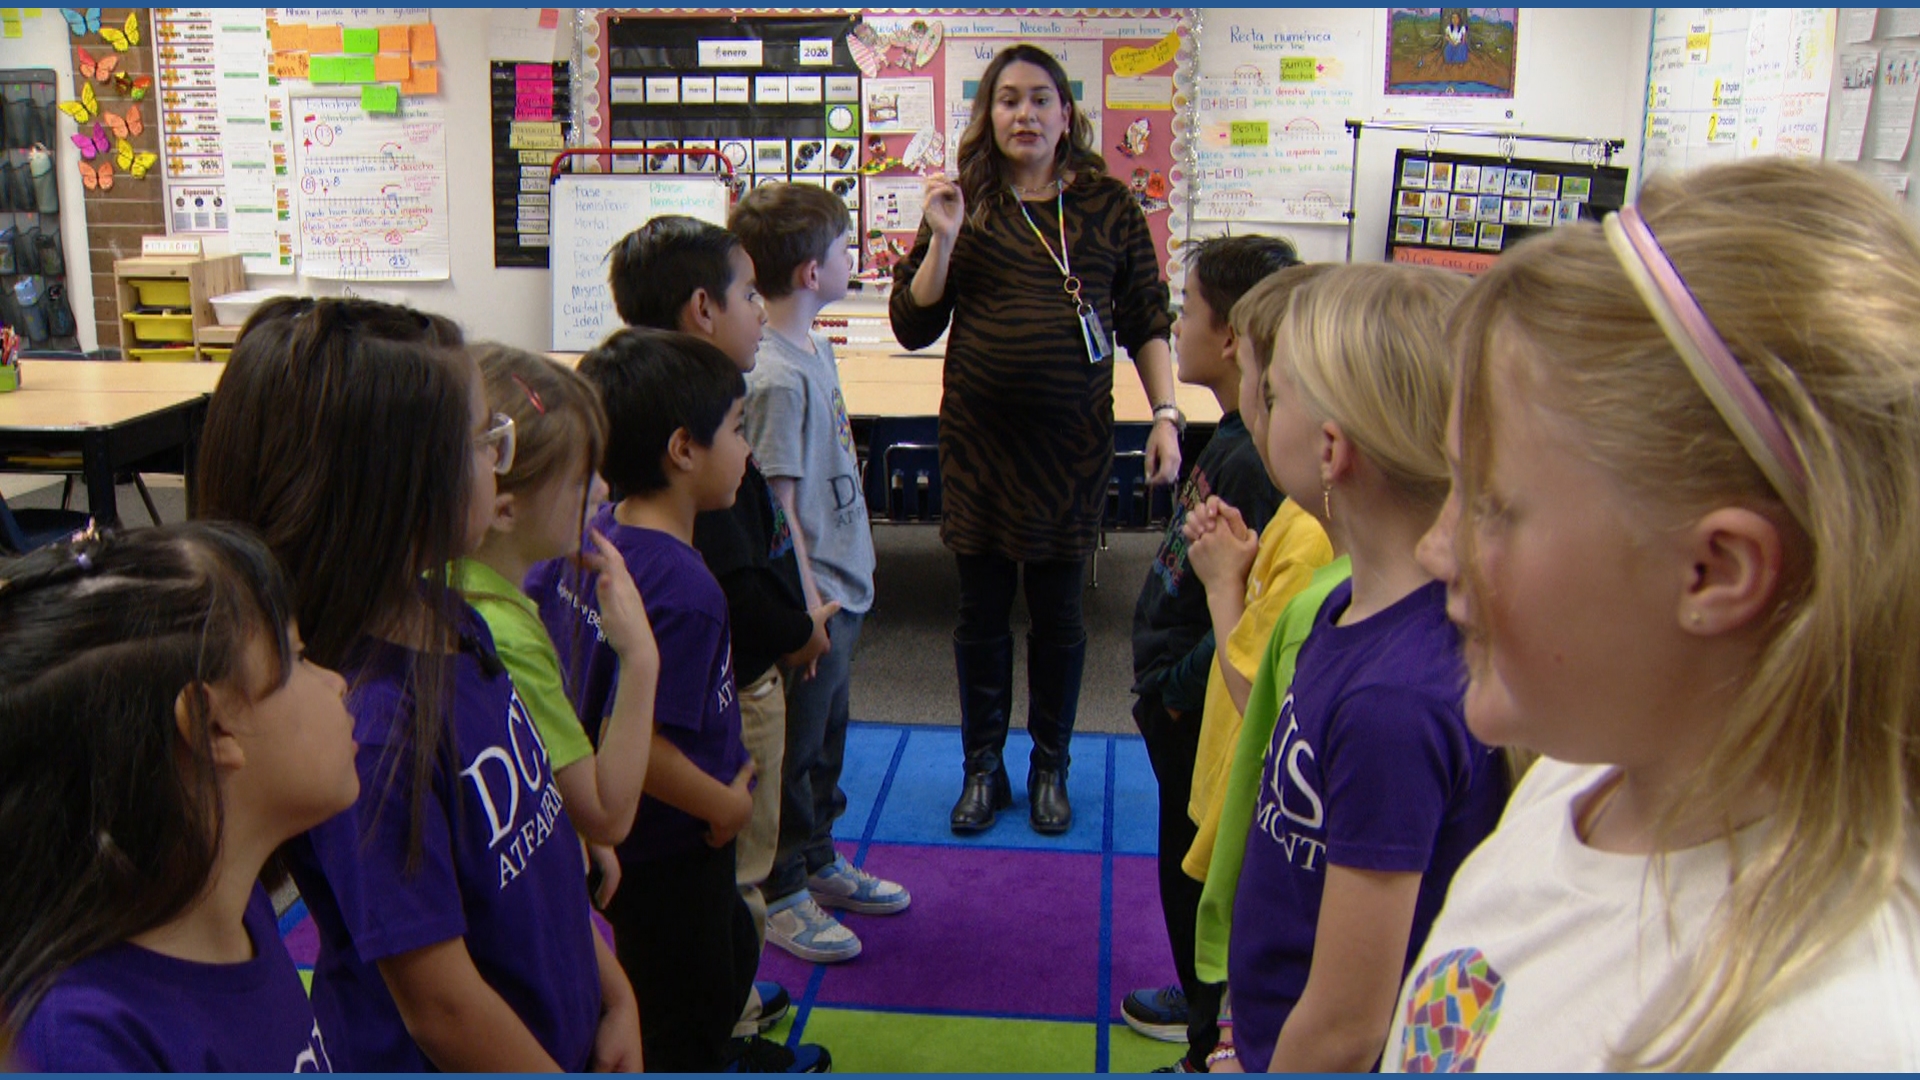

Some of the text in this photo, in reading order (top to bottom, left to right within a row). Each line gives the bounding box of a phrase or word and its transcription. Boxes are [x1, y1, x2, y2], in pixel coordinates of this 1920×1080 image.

[1020, 22, 1060, 33] Necesito
[1230, 25, 1264, 43] Recta
[722, 49, 747, 57] enero
[804, 48, 828, 57] 2026
[183, 188, 214, 198] Especiales
[576, 186, 600, 198] Fase
[1268, 692, 1324, 828] CIS
[459, 687, 549, 849] DCI
[1258, 802, 1326, 871] MONT
